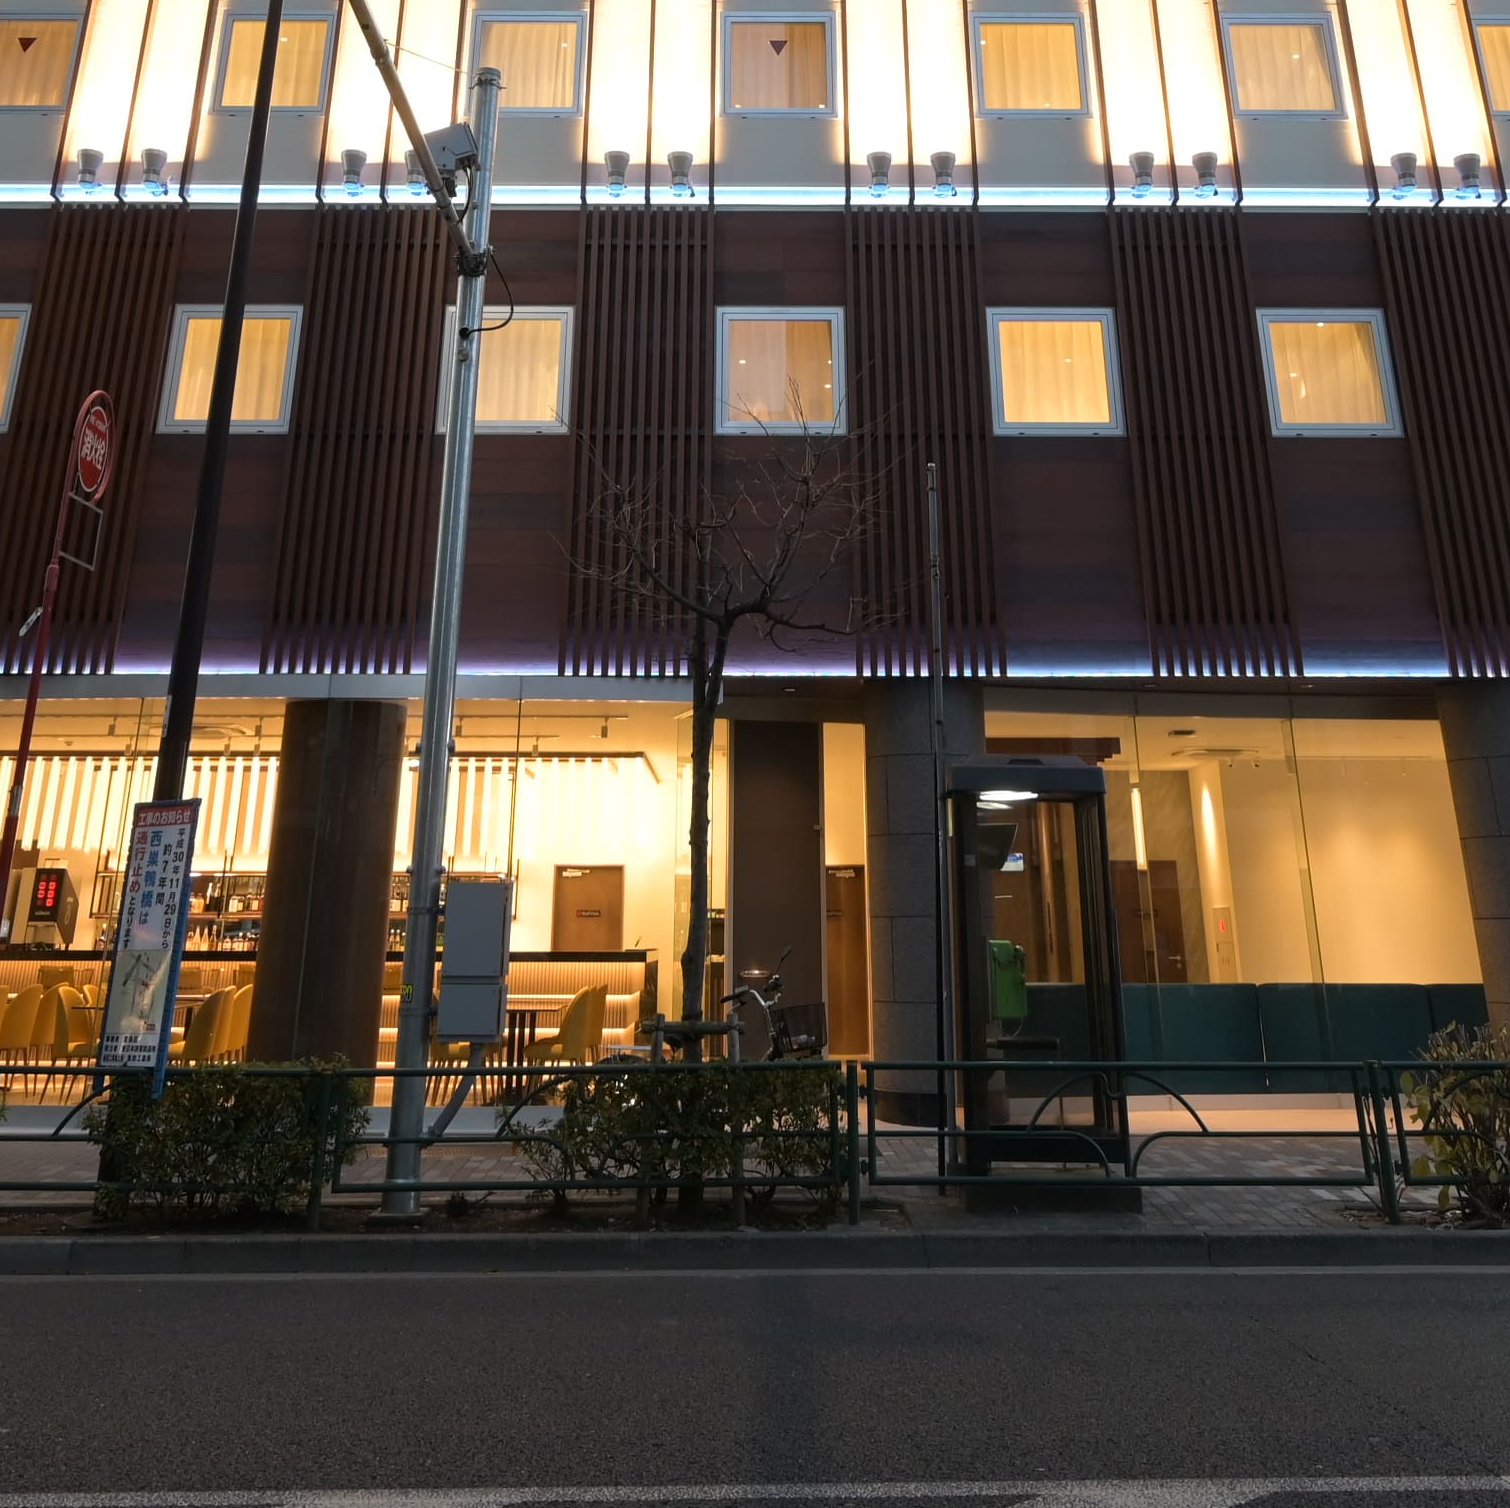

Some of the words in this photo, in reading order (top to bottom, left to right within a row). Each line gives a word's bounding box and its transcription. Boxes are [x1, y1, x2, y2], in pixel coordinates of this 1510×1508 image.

[138, 810, 191, 826] 工事のお知らせ
[139, 830, 163, 925] 西巣鴨橋は
[155, 843, 173, 906] 約7年間
[161, 827, 186, 949] 平成30年11月29日から
